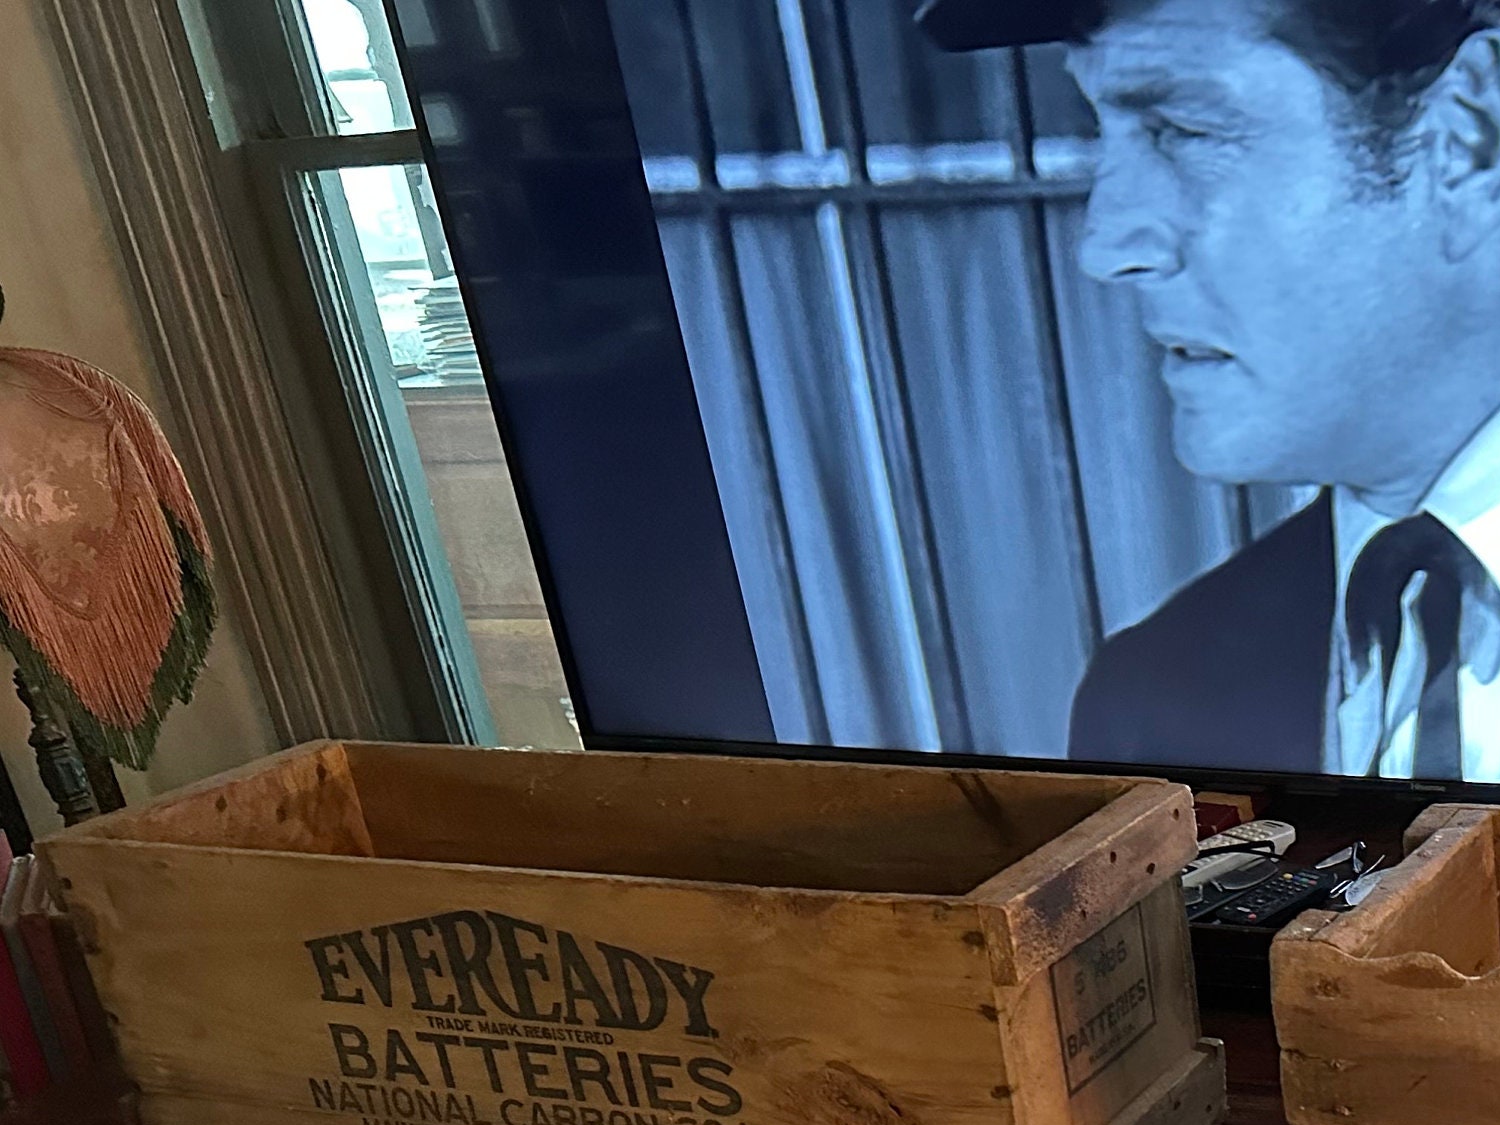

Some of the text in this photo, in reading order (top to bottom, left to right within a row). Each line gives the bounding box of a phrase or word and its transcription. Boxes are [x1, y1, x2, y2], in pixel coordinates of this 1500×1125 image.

[304, 909, 720, 1039] EVEREADY
[1066, 977, 1147, 1059] BATTERIES
[329, 1022, 743, 1116] BATTERIES
[426, 1015, 614, 1046] TRADE MARK REGISTERED
